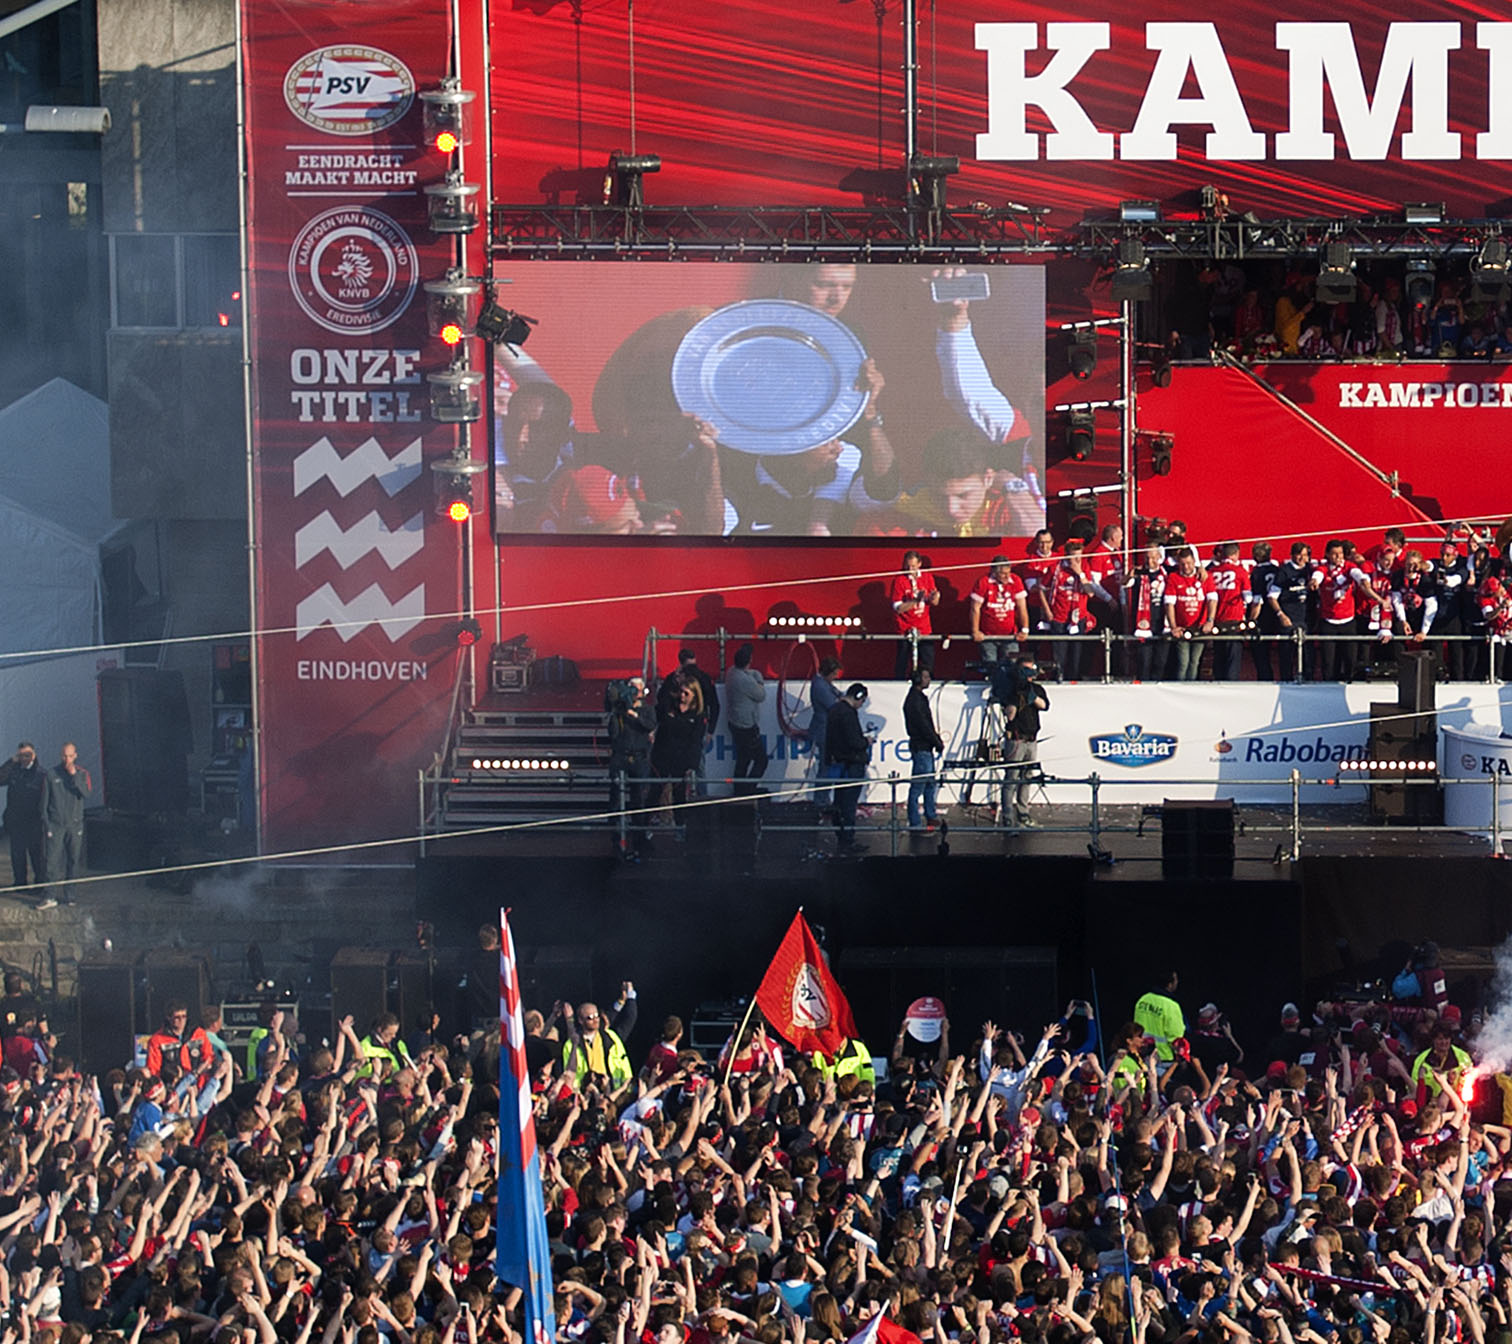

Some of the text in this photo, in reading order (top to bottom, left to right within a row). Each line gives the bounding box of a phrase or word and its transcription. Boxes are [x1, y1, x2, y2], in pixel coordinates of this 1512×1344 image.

[326, 76, 372, 95] PSV
[298, 154, 404, 169] EENDRACHT
[285, 171, 418, 185] MAAKT MACHT
[297, 212, 409, 266] KAMPIOEN VAN NEDERLAND
[338, 288, 371, 299] KNVB
[325, 307, 382, 326] EREDIVISIE
[291, 348, 422, 385] ONZE
[291, 391, 422, 423] TITEL
[1211, 570, 1237, 590] 22
[297, 660, 427, 681] EINDHOVEN
[1096, 739, 1171, 757] Bavaria
[1245, 736, 1371, 763] Raboban
